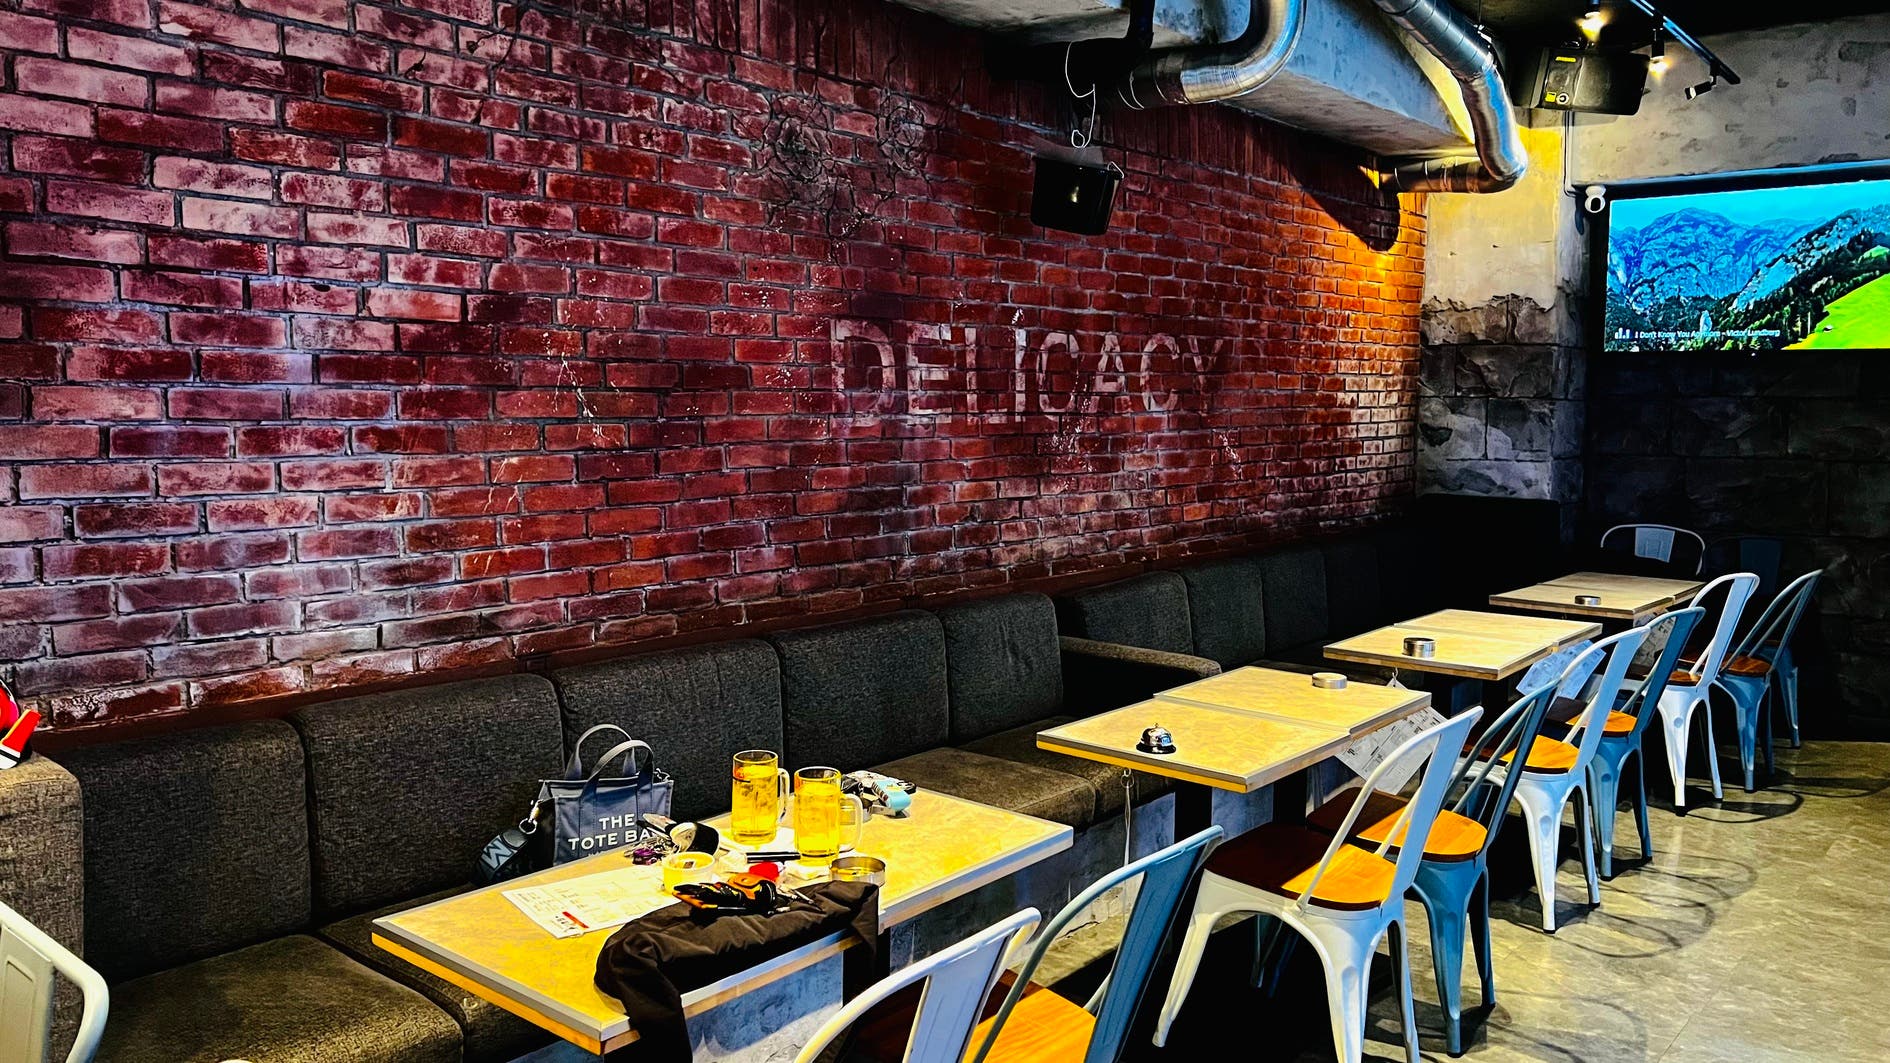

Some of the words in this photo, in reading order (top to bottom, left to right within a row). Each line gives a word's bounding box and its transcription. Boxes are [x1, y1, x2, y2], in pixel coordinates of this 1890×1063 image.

[1640, 331, 1657, 339] Don't
[1677, 330, 1690, 338] You
[830, 318, 1224, 427] DELICACY
[599, 813, 635, 830] THE
[568, 832, 618, 851] TOTE
[624, 828, 658, 843] BA
